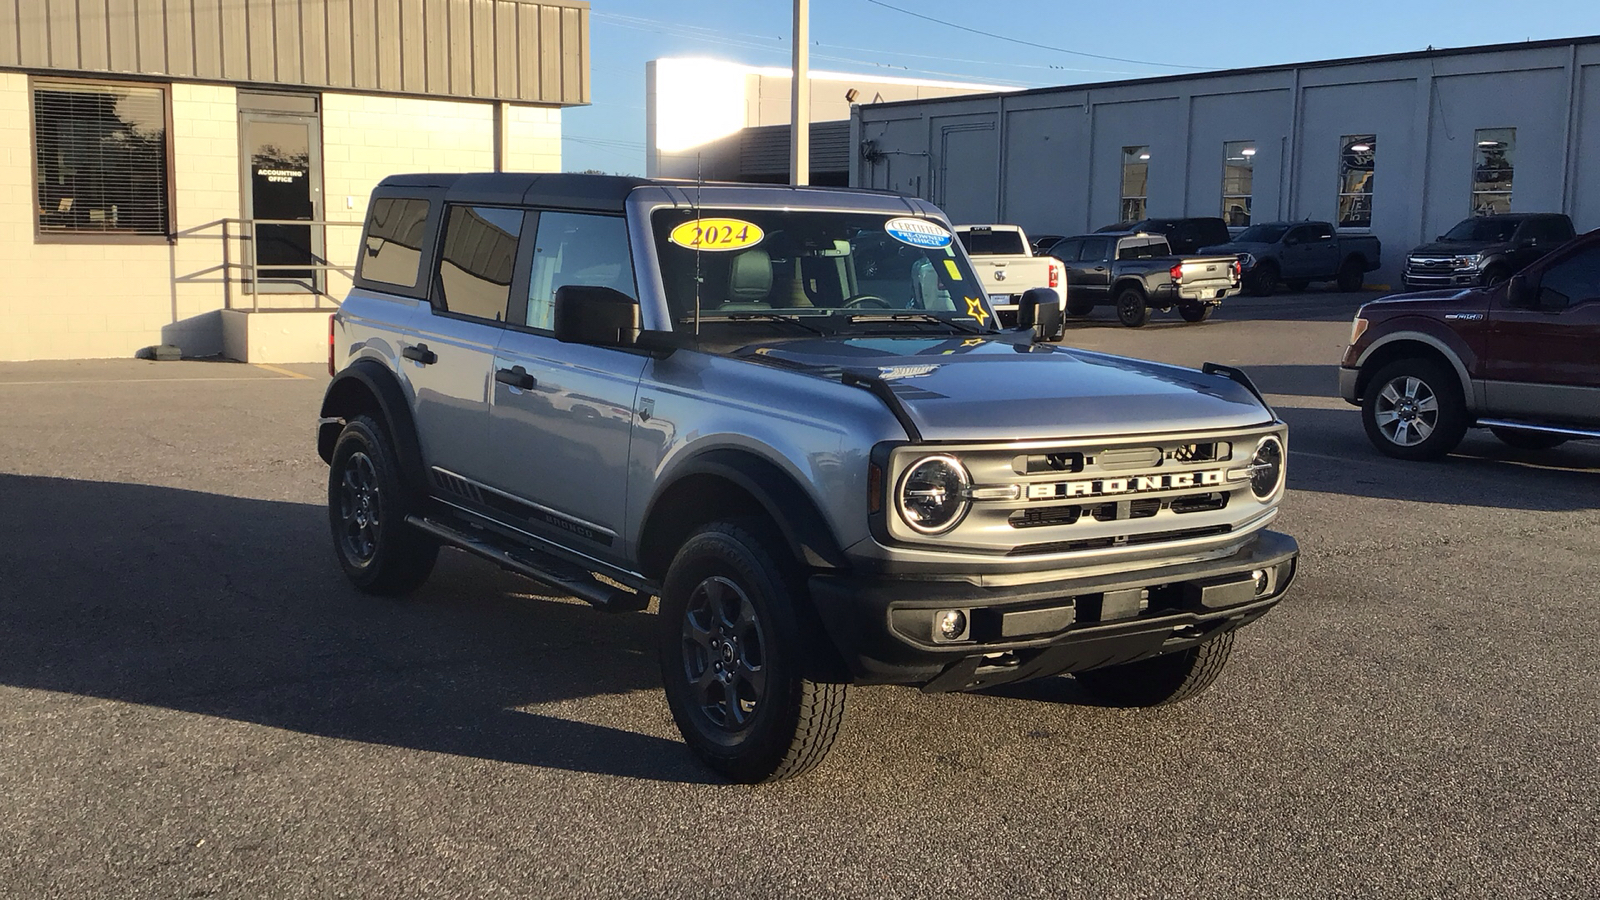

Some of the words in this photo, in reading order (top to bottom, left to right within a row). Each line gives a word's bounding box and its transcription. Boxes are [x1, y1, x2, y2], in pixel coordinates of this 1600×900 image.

[258, 169, 302, 177] ACCOUNTING
[690, 225, 749, 245] 2024
[891, 221, 943, 236] CERTIFIED
[906, 237, 942, 246] VEHICLE
[1028, 470, 1224, 499] BRONCO
